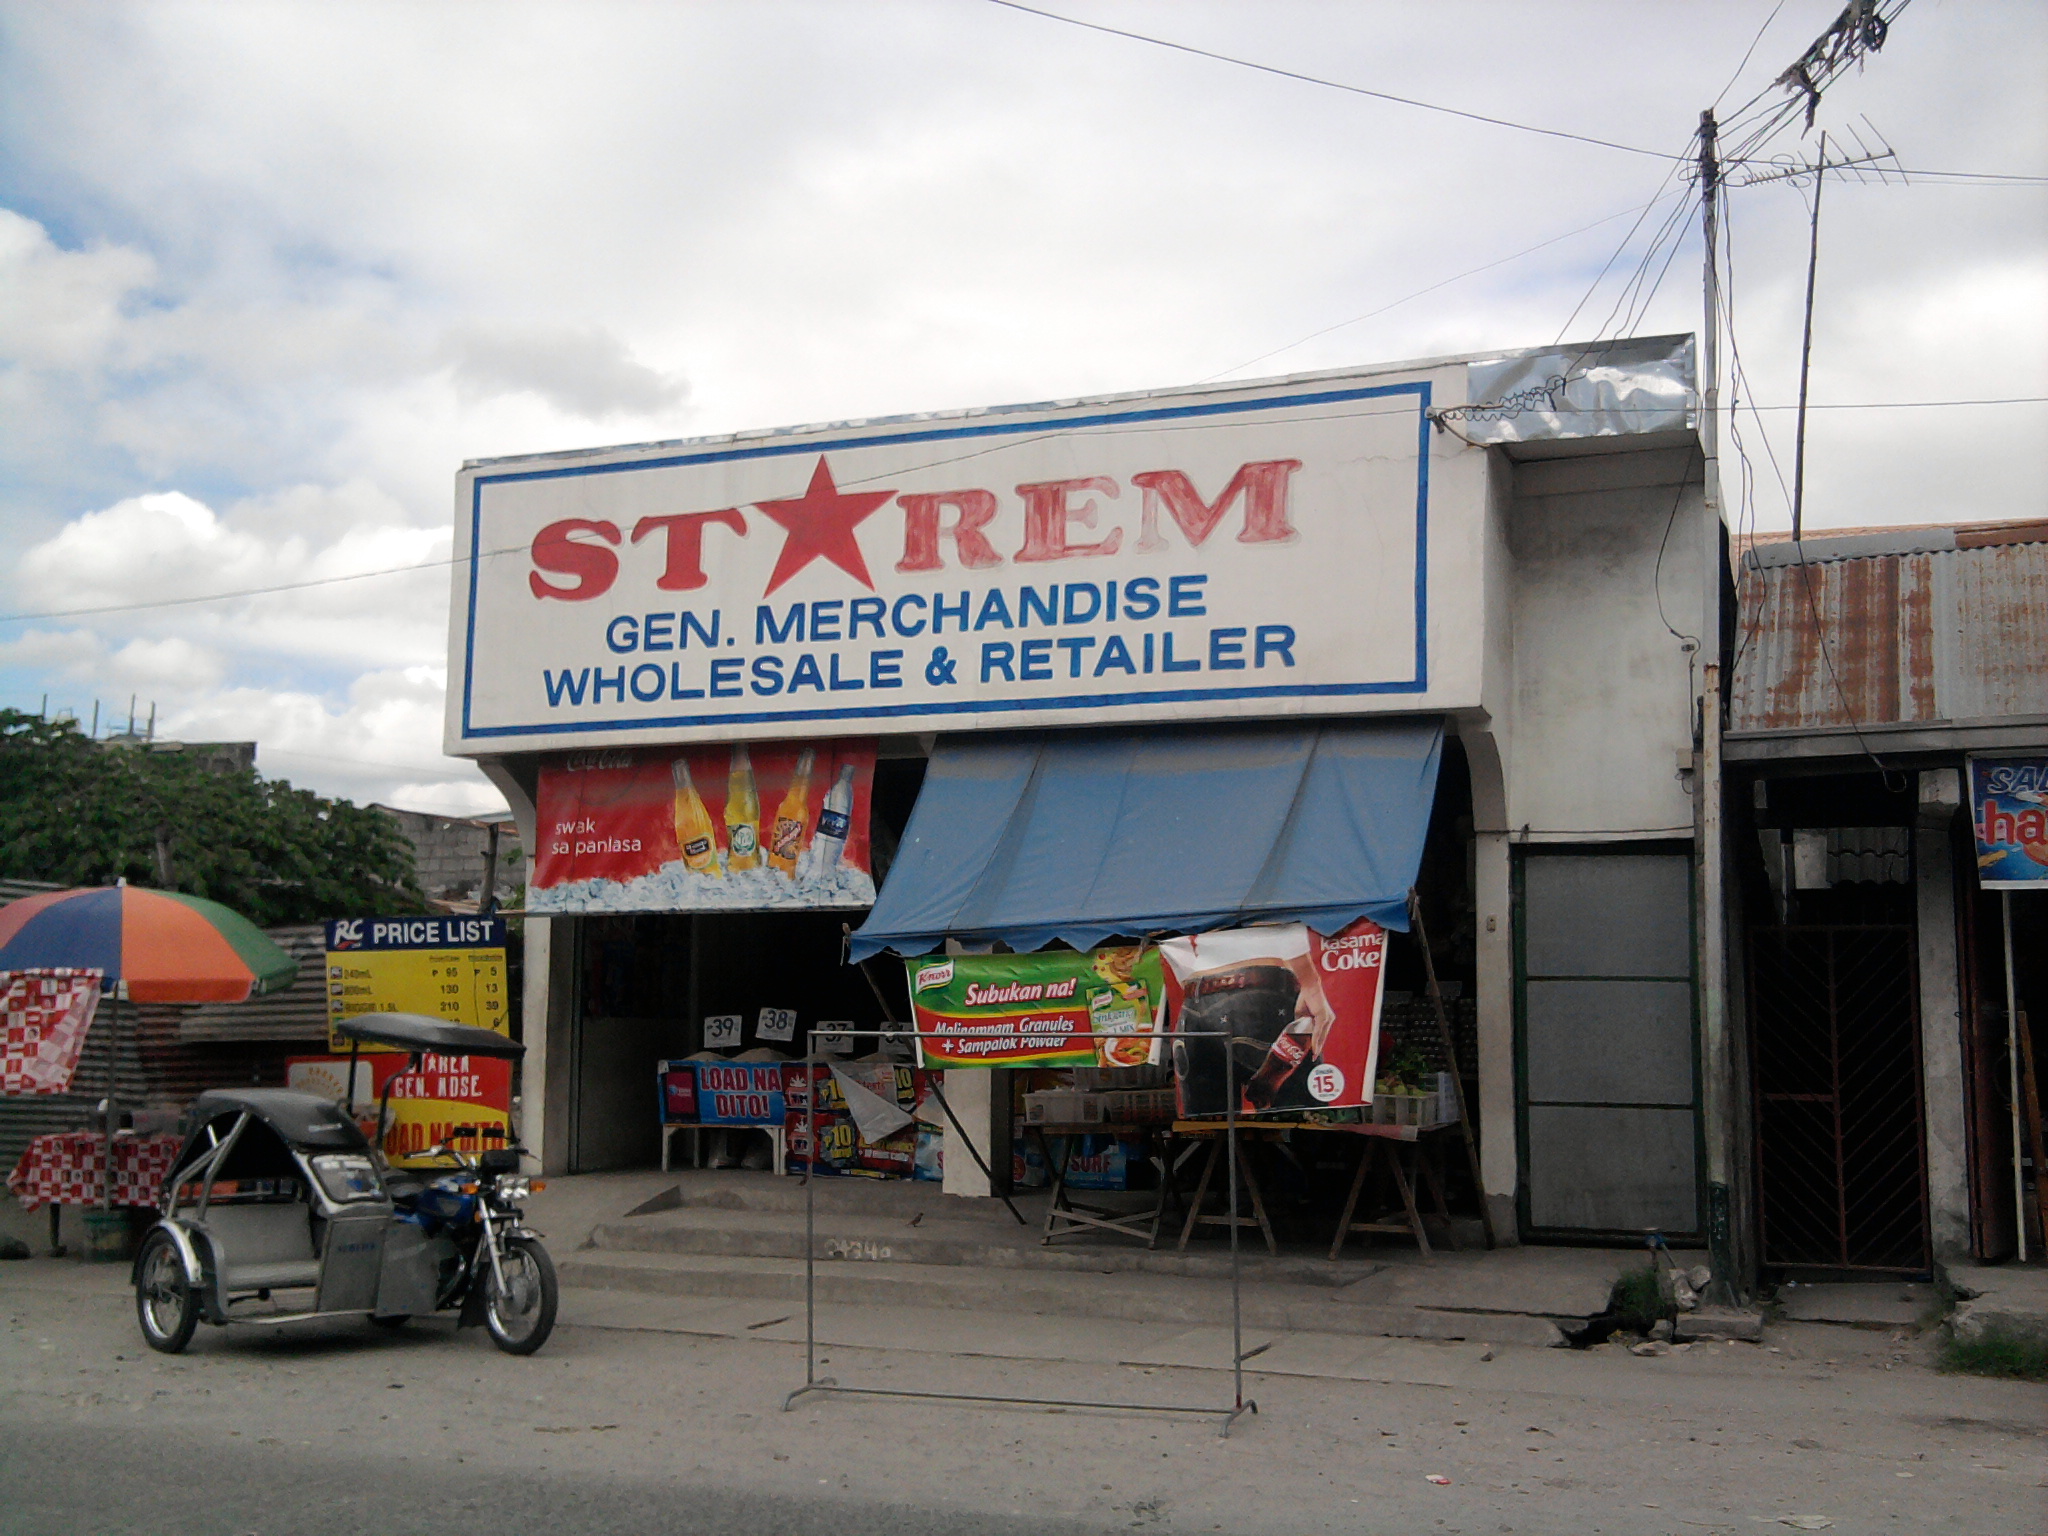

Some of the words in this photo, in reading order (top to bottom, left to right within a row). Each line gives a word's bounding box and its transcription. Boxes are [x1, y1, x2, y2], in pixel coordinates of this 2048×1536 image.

[606, 609, 735, 654] GEN.
[755, 574, 1208, 645] MERCHANDISE
[543, 649, 904, 708] WHOLESALE
[925, 646, 957, 686] &
[980, 625, 1296, 683] RETAILER
[555, 817, 596, 835] swak
[552, 841, 570, 855] sa
[575, 836, 642, 858] panlasa
[373, 922, 440, 944] PRICE
[447, 921, 494, 942] LIST
[1321, 948, 1380, 972] Coke
[918, 968, 951, 985] Knorr
[965, 980, 1043, 1006] Subukan
[1046, 977, 1078, 998] na!
[765, 1010, 788, 1030] 38
[1019, 1015, 1075, 1033] Granules
[957, 1037, 1018, 1056] Sampalok
[700, 1067, 749, 1091] LOAD
[754, 1068, 782, 1091] NA
[716, 1094, 770, 1117] DITO!
[386, 1122, 423, 1155] OAD
[1070, 1155, 1112, 1173] SURF
